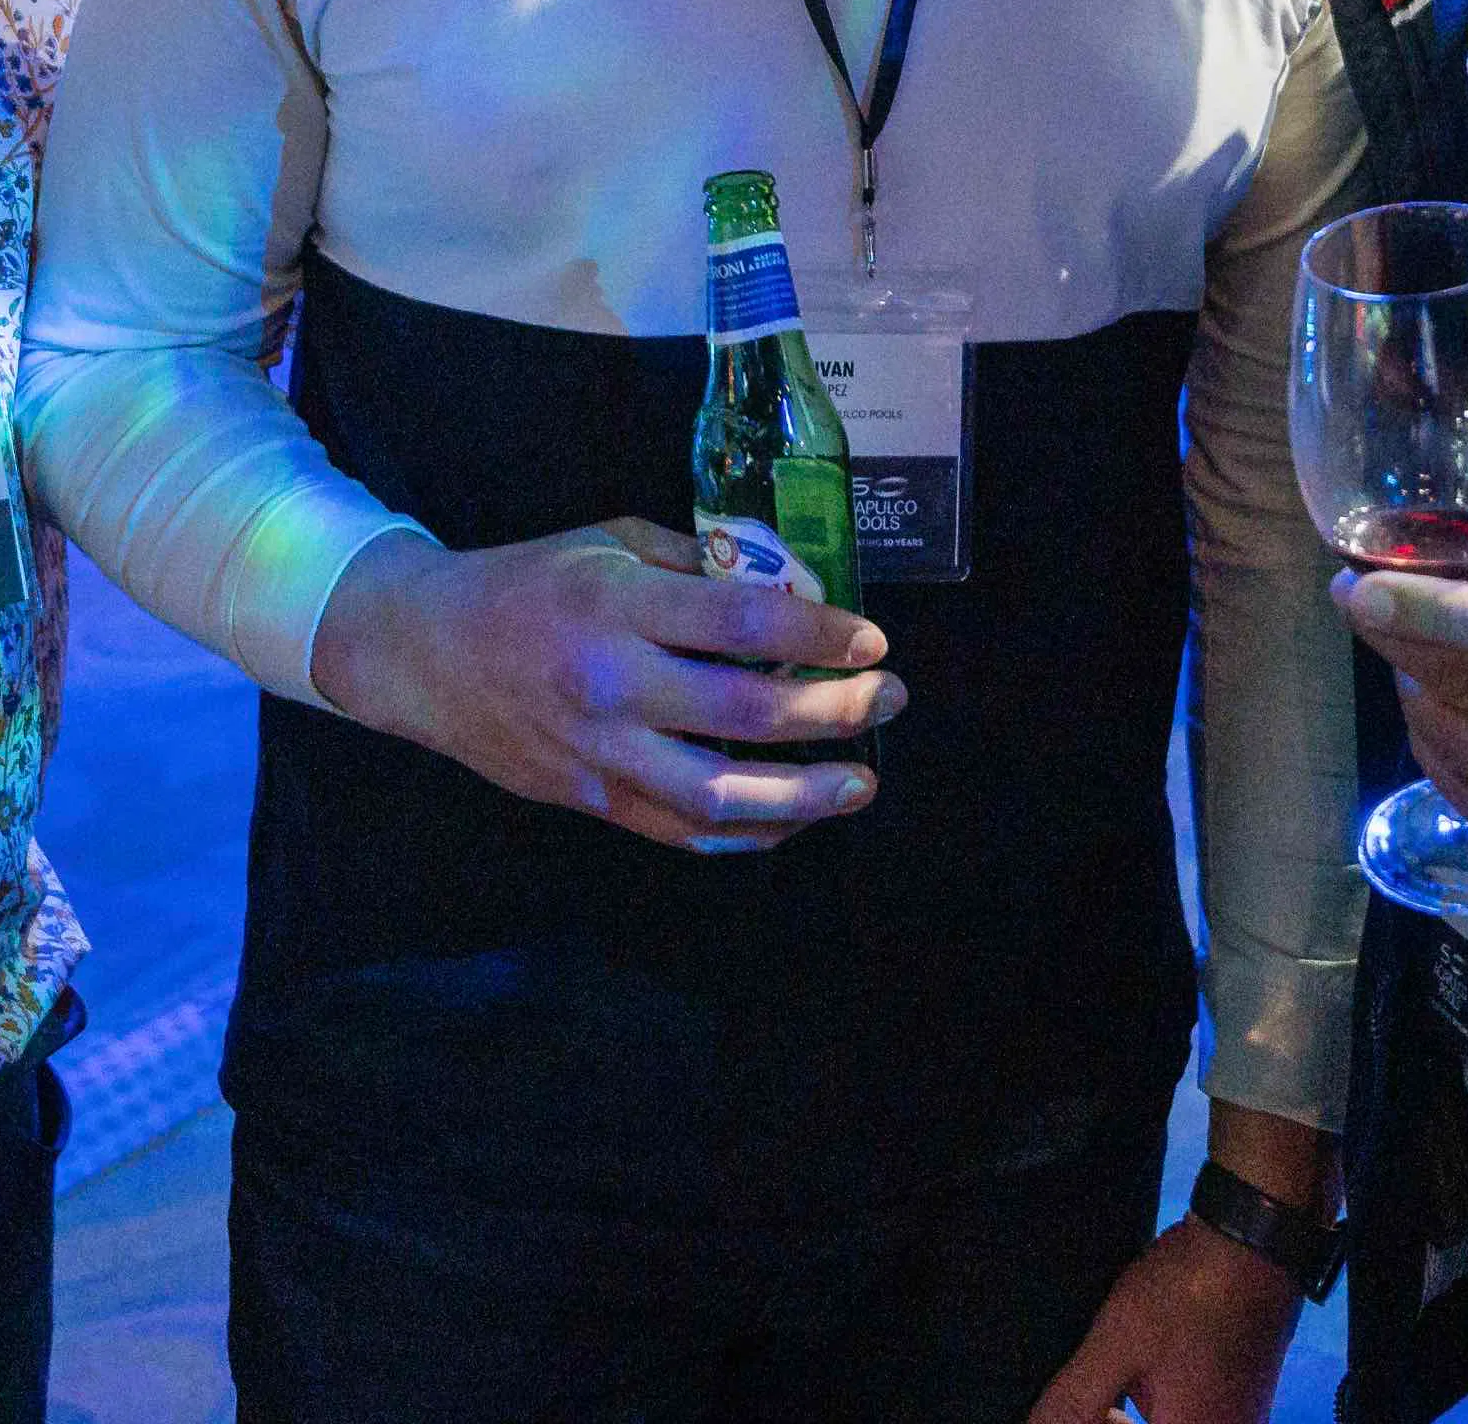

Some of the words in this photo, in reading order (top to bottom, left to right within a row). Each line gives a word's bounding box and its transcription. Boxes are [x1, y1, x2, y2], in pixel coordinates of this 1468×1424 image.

[711, 260, 746, 279] RONI
[815, 361, 854, 377] IVAN
[828, 383, 847, 397] PEZ
[855, 500, 918, 515] APULCO
[858, 516, 901, 531] OOLS
[895, 538, 924, 547] YEARS
